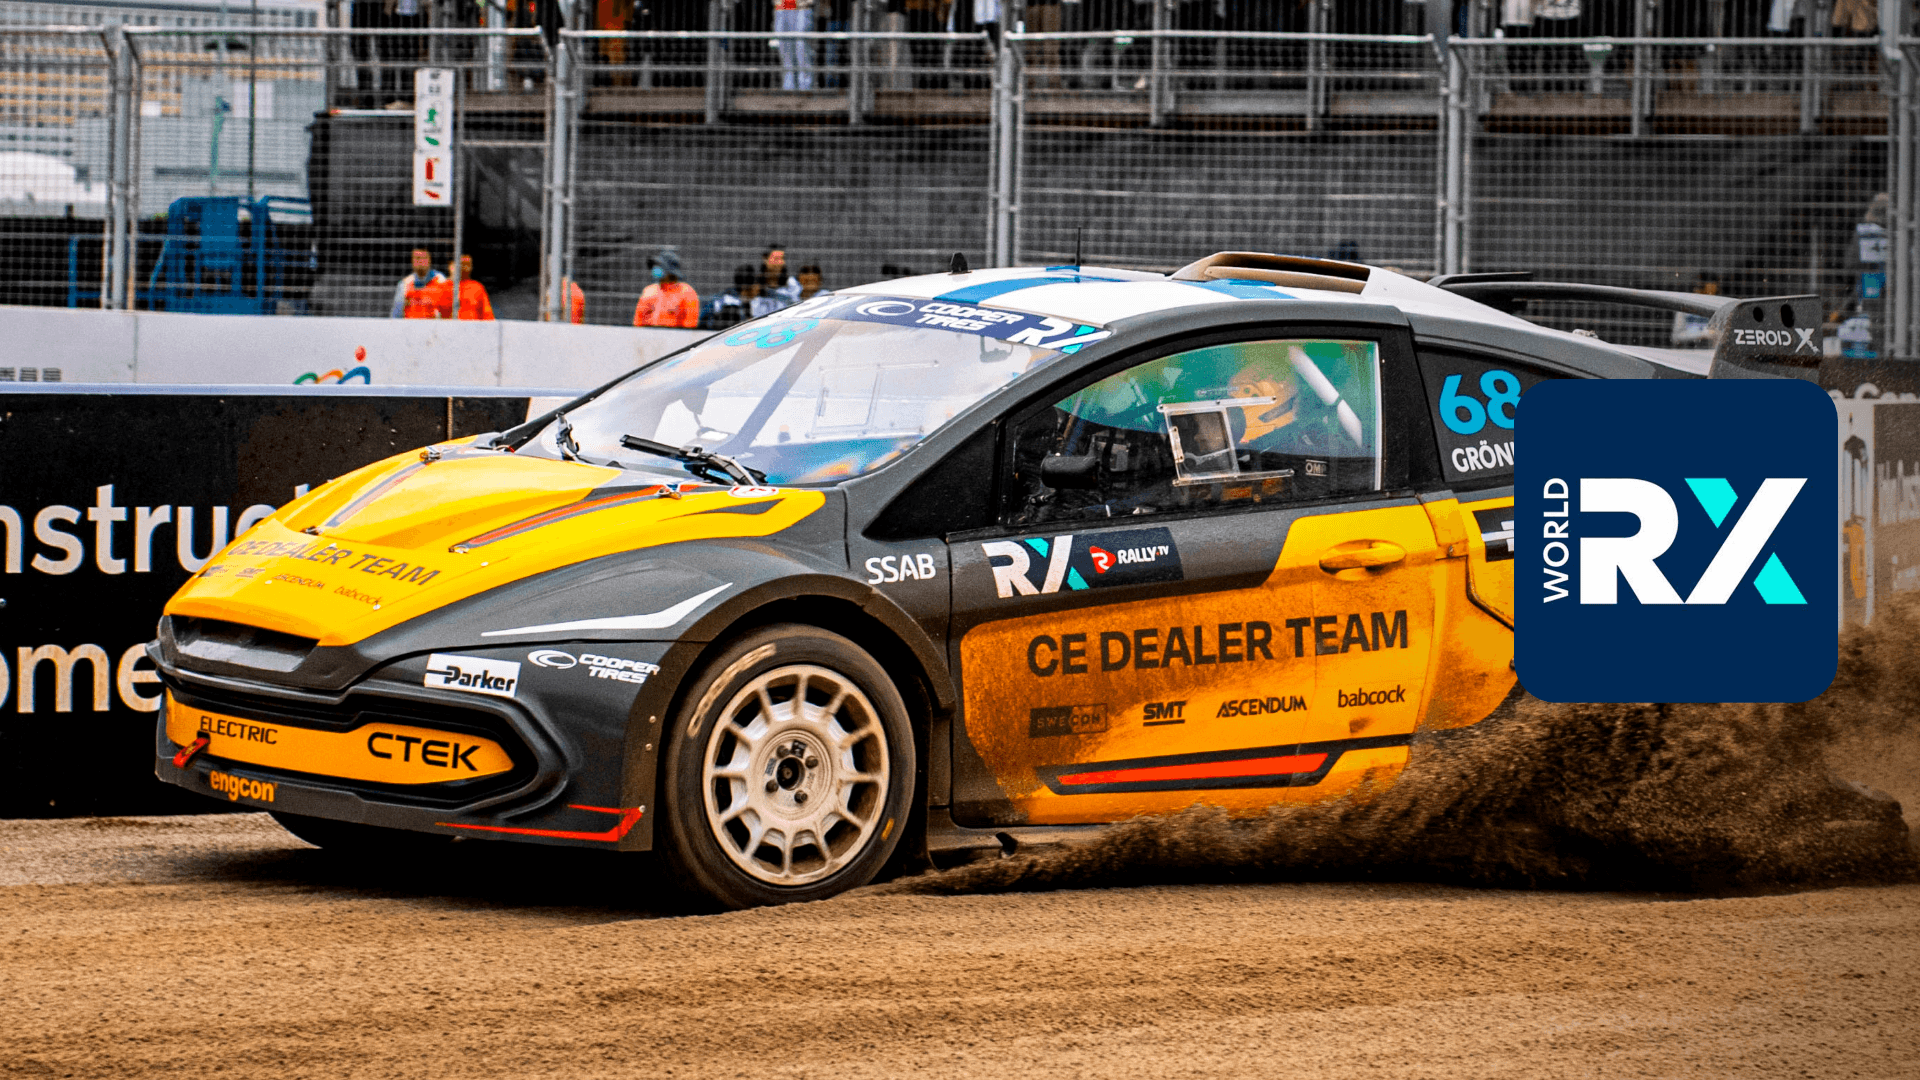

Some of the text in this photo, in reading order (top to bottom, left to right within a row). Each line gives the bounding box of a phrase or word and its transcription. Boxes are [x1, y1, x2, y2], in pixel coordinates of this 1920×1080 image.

[915, 313, 996, 331] TIRES
[919, 302, 1025, 325] COOPER
[1006, 317, 1112, 355] RX
[1734, 328, 1791, 346] ZEROID
[1439, 369, 1522, 435] 68
[252, 541, 352, 565] DEALER
[348, 553, 441, 585] TEAM
[865, 553, 936, 585] SSAB
[981, 535, 1090, 598] RX
[333, 585, 382, 606] babcock
[1027, 609, 1408, 677] CE DEALER TEAM
[444, 665, 515, 692] Parker
[578, 653, 661, 675] COOPER
[587, 665, 648, 684] TIRES
[1143, 701, 1187, 721] SMT
[1216, 695, 1307, 719] ASCENDUM
[1338, 685, 1405, 708] babcock
[200, 715, 481, 771] ELECTRIC CTEK
[210, 769, 275, 802] engcon
